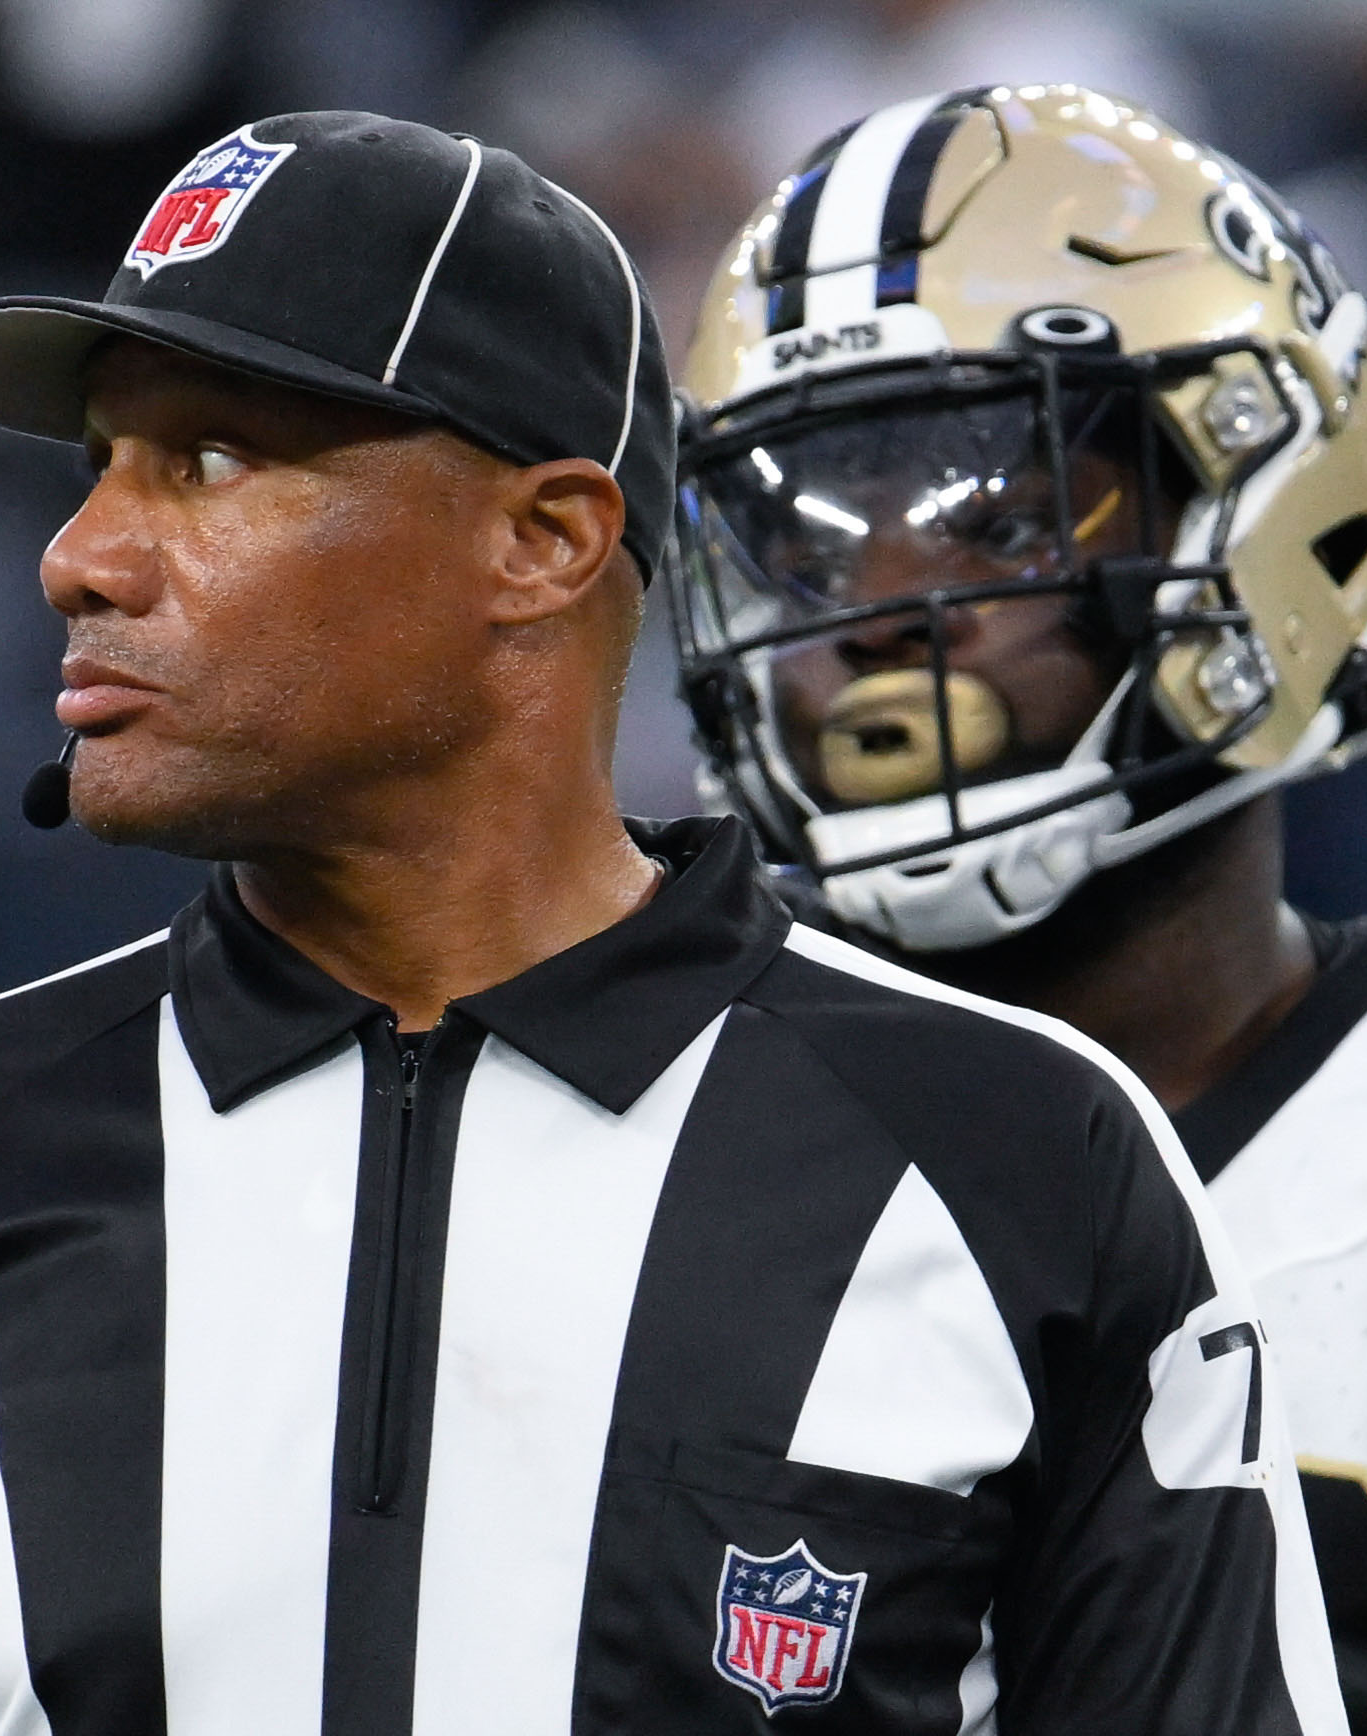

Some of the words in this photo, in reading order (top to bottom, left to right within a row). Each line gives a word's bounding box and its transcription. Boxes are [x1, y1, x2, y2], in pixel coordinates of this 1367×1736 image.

[137, 187, 231, 256] NFL
[773, 321, 882, 371] SAINTS
[1198, 1319, 1269, 1465] 7
[729, 1607, 830, 1691] NFL
